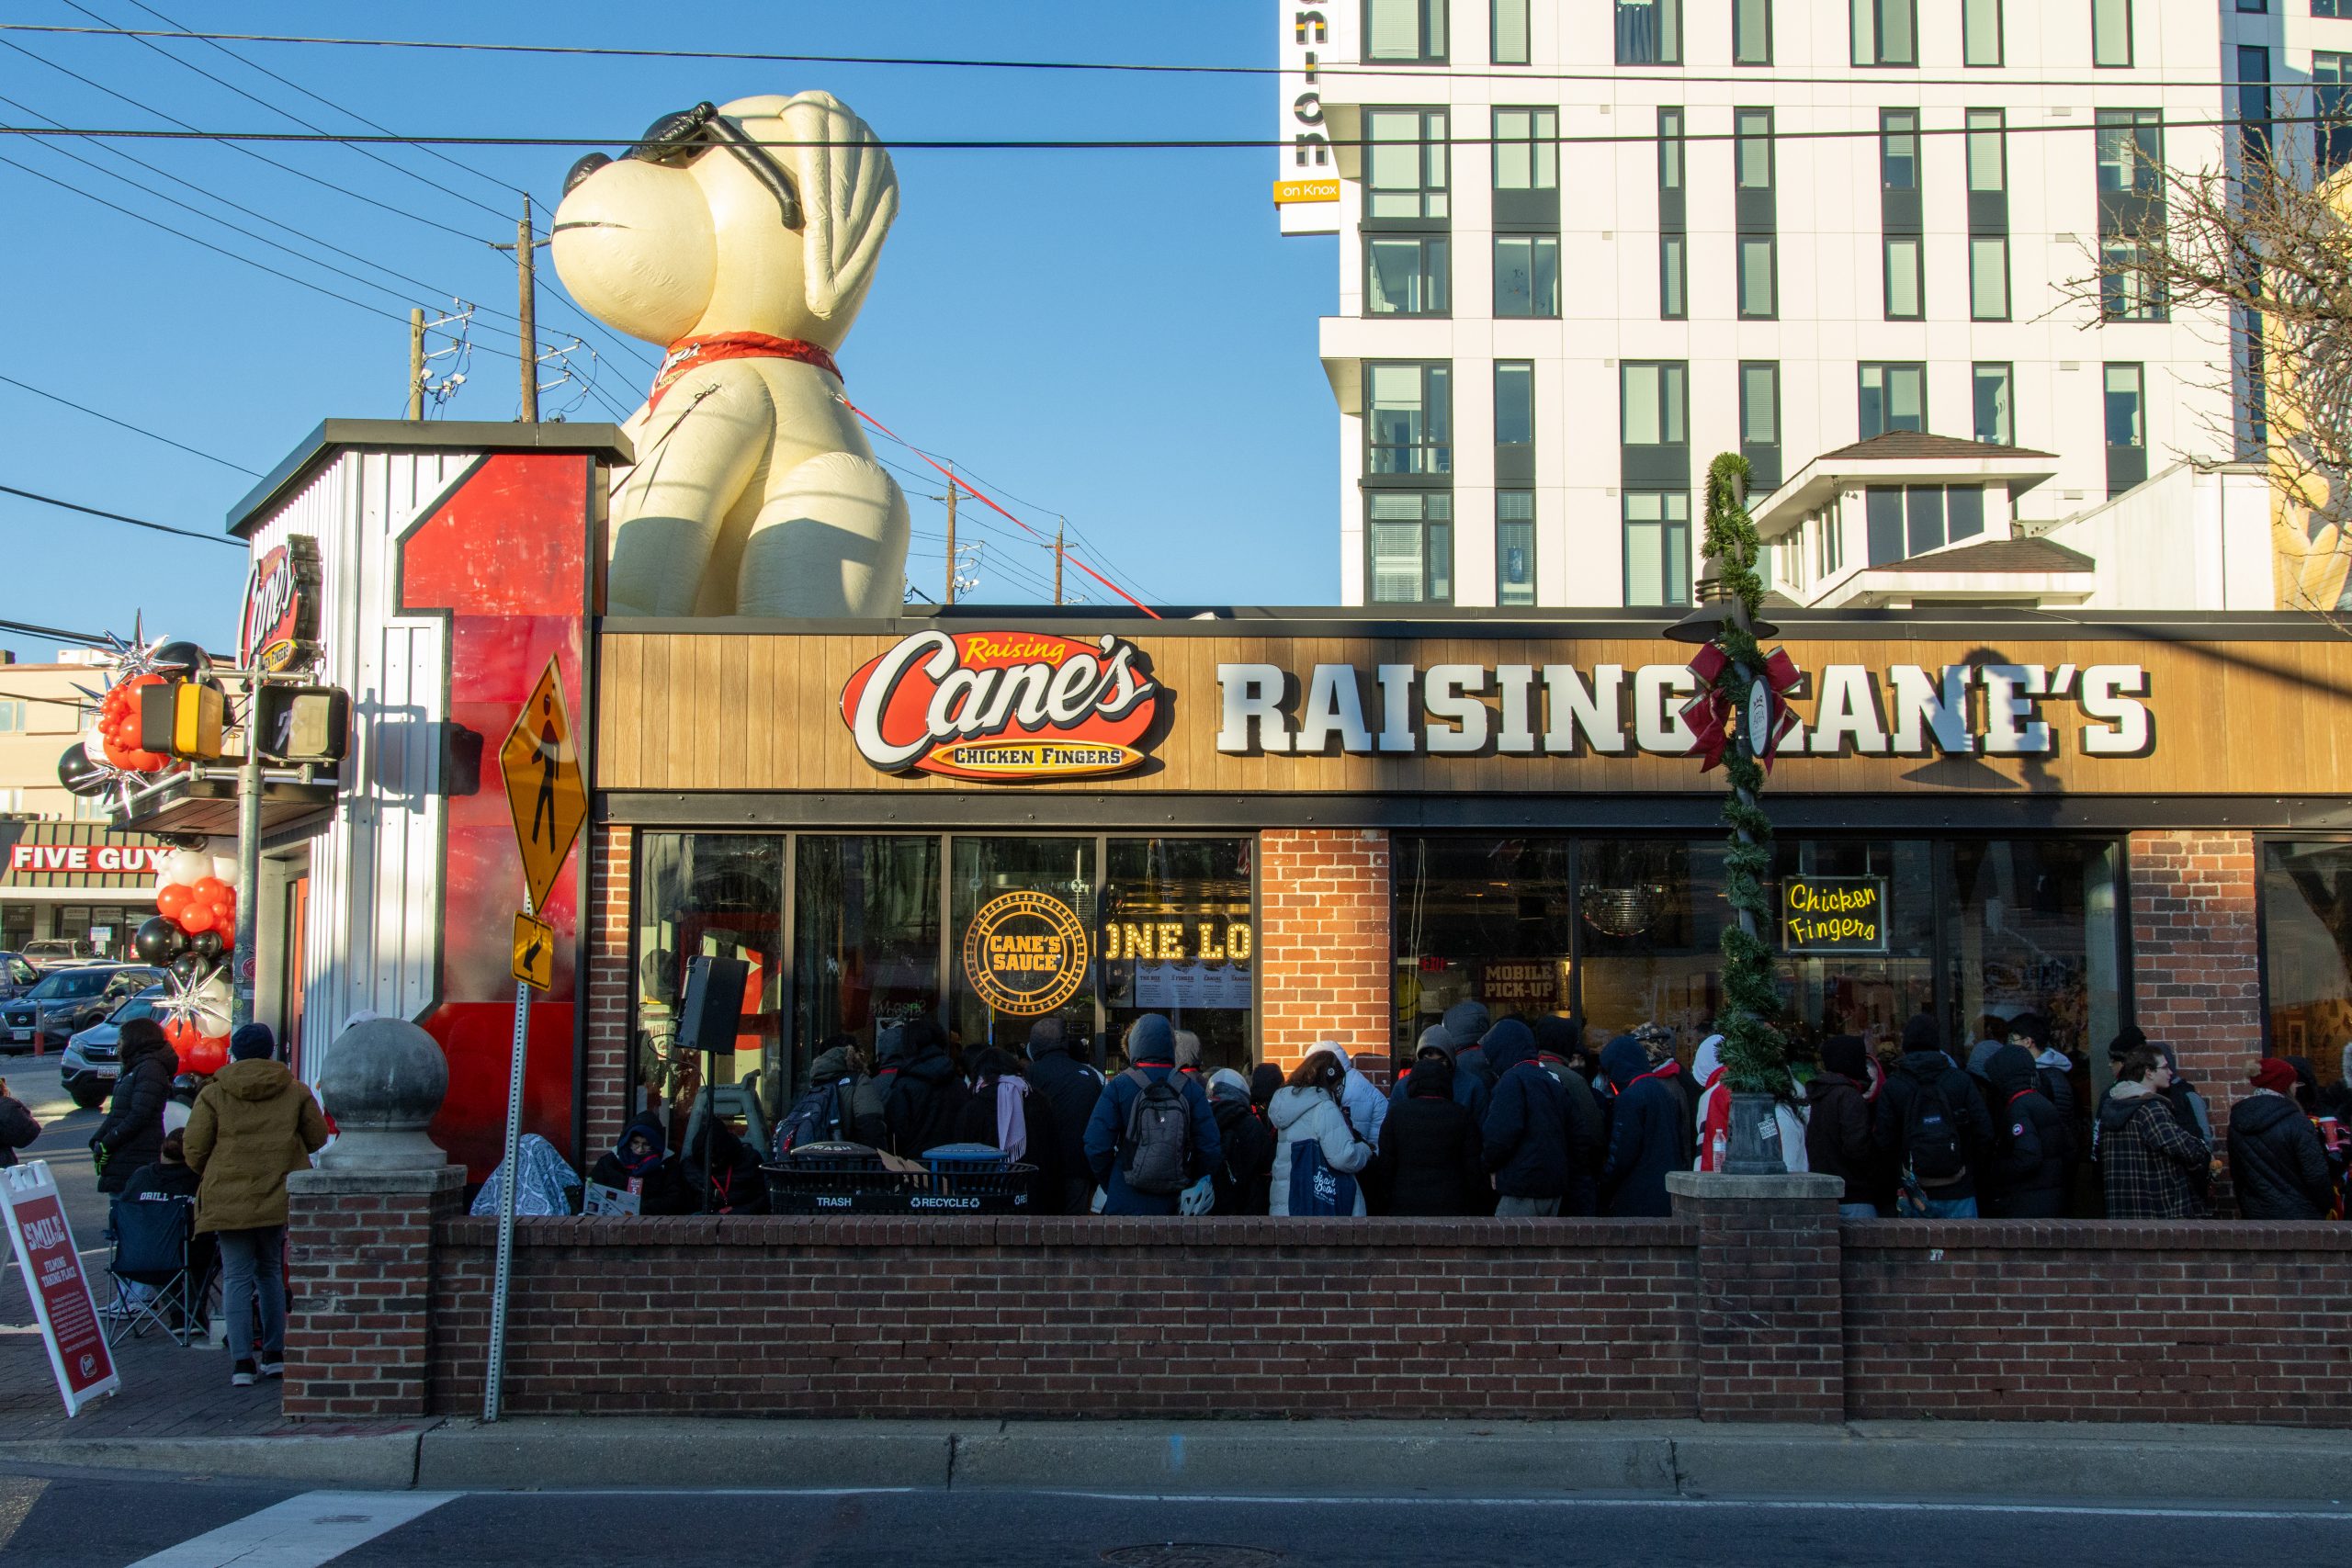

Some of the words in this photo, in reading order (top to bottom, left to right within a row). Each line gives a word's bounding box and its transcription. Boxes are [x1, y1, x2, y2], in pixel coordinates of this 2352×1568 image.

[1283, 185, 1300, 197] on
[1304, 183, 1337, 196] Knox
[964, 637, 1066, 666] Raising
[854, 629, 1155, 764] Cane's
[1216, 663, 1700, 754] RAISING
[1769, 663, 2149, 754] ANE'S
[954, 747, 1035, 764] CHICKEN
[1040, 747, 1122, 765] FINGERS
[14, 847, 88, 869] FIVE
[97, 847, 170, 870] GUY
[1791, 884, 1876, 911] Chicken
[1788, 918, 1875, 944] Fingers
[990, 935, 1061, 953] CANE'S
[1093, 923, 1183, 959] ONE
[993, 954, 1057, 971] SAUCE
[1485, 965, 1555, 980] MOBILE
[1484, 982, 1554, 998] PICK-UP
[140, 1191, 169, 1201] DRILL
[816, 1197, 852, 1207] TRASH
[922, 1198, 969, 1208] RECYCLE
[23, 1214, 66, 1250] SMILE
[43, 1256, 66, 1273] FILMING
[40, 1269, 61, 1288] TAKING
[61, 1266, 77, 1281] PLACE
